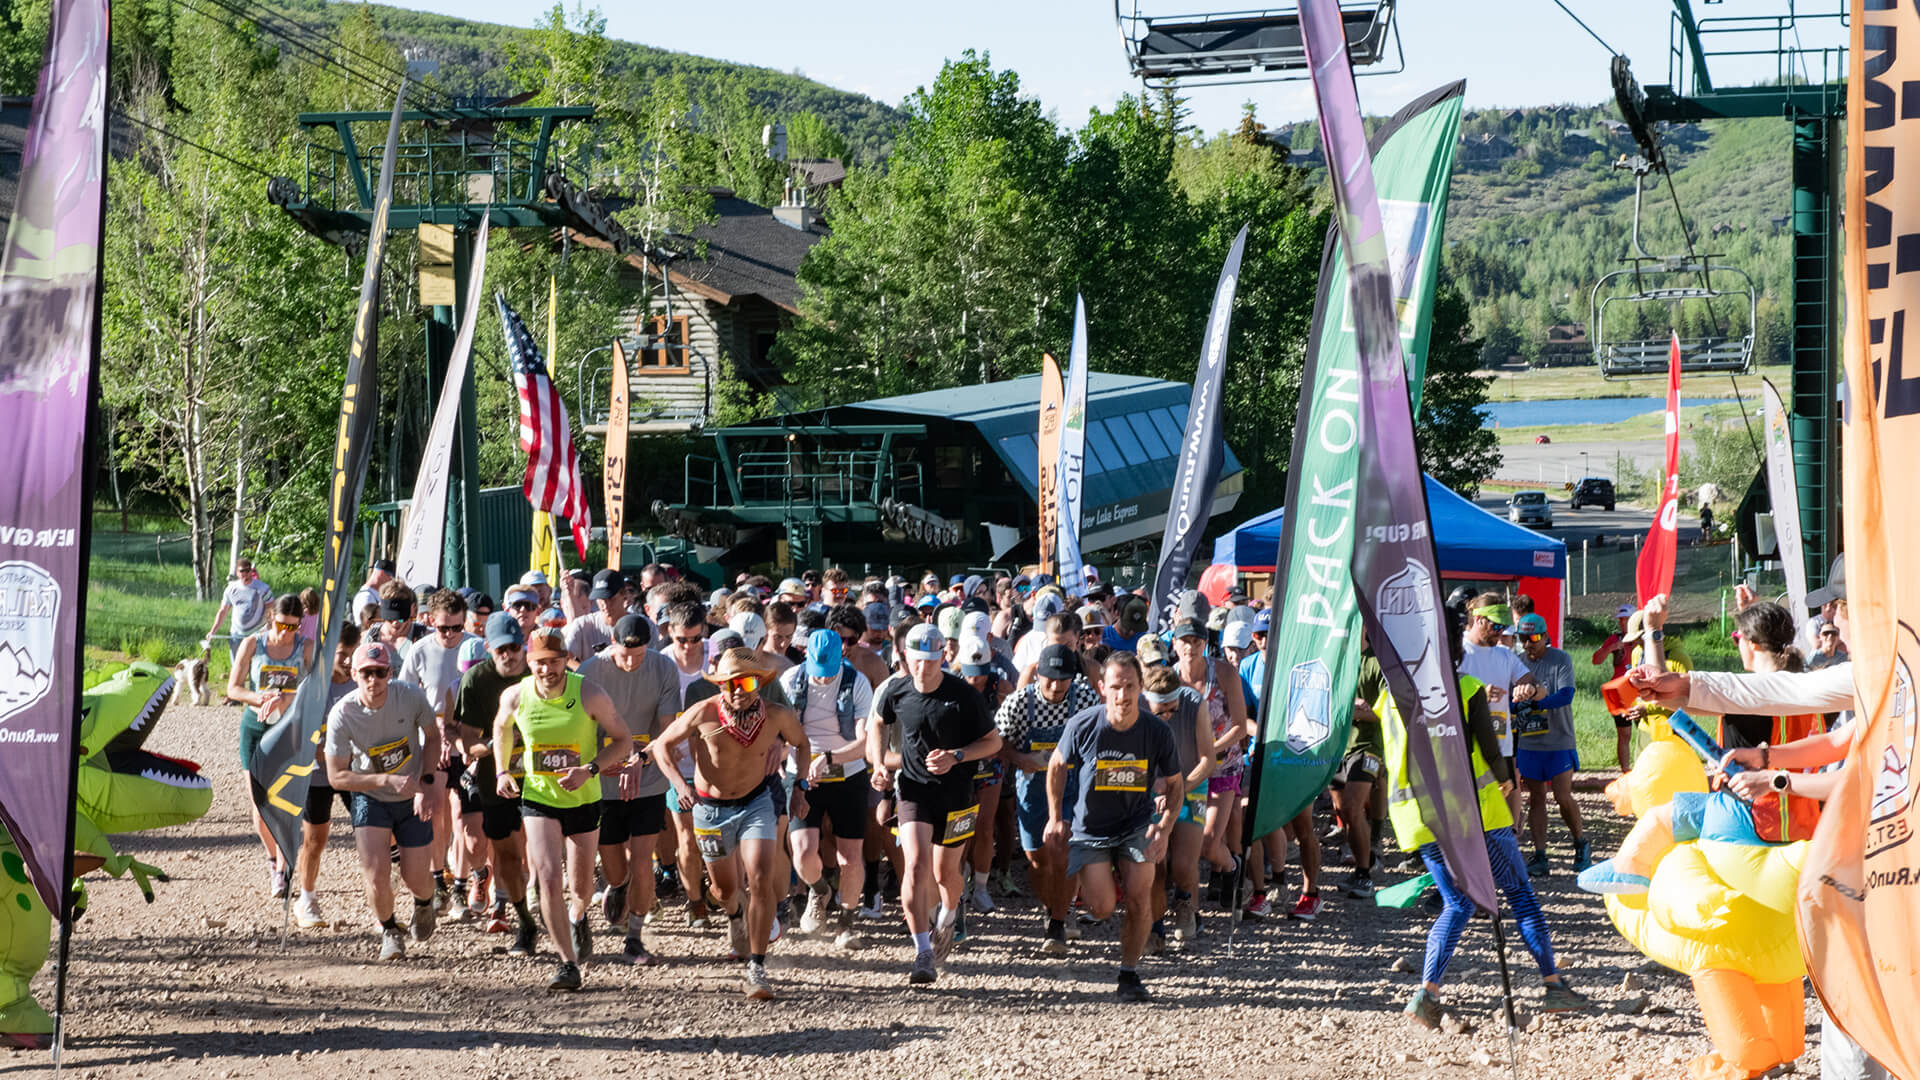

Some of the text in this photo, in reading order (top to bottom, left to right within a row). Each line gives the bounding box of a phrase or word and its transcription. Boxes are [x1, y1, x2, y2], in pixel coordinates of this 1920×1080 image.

[1320, 367, 1359, 454] ON
[1096, 507, 1113, 526] Lake
[1113, 503, 1139, 524] Express
[543, 754, 568, 767] 491
[1107, 771, 1135, 784] 208
